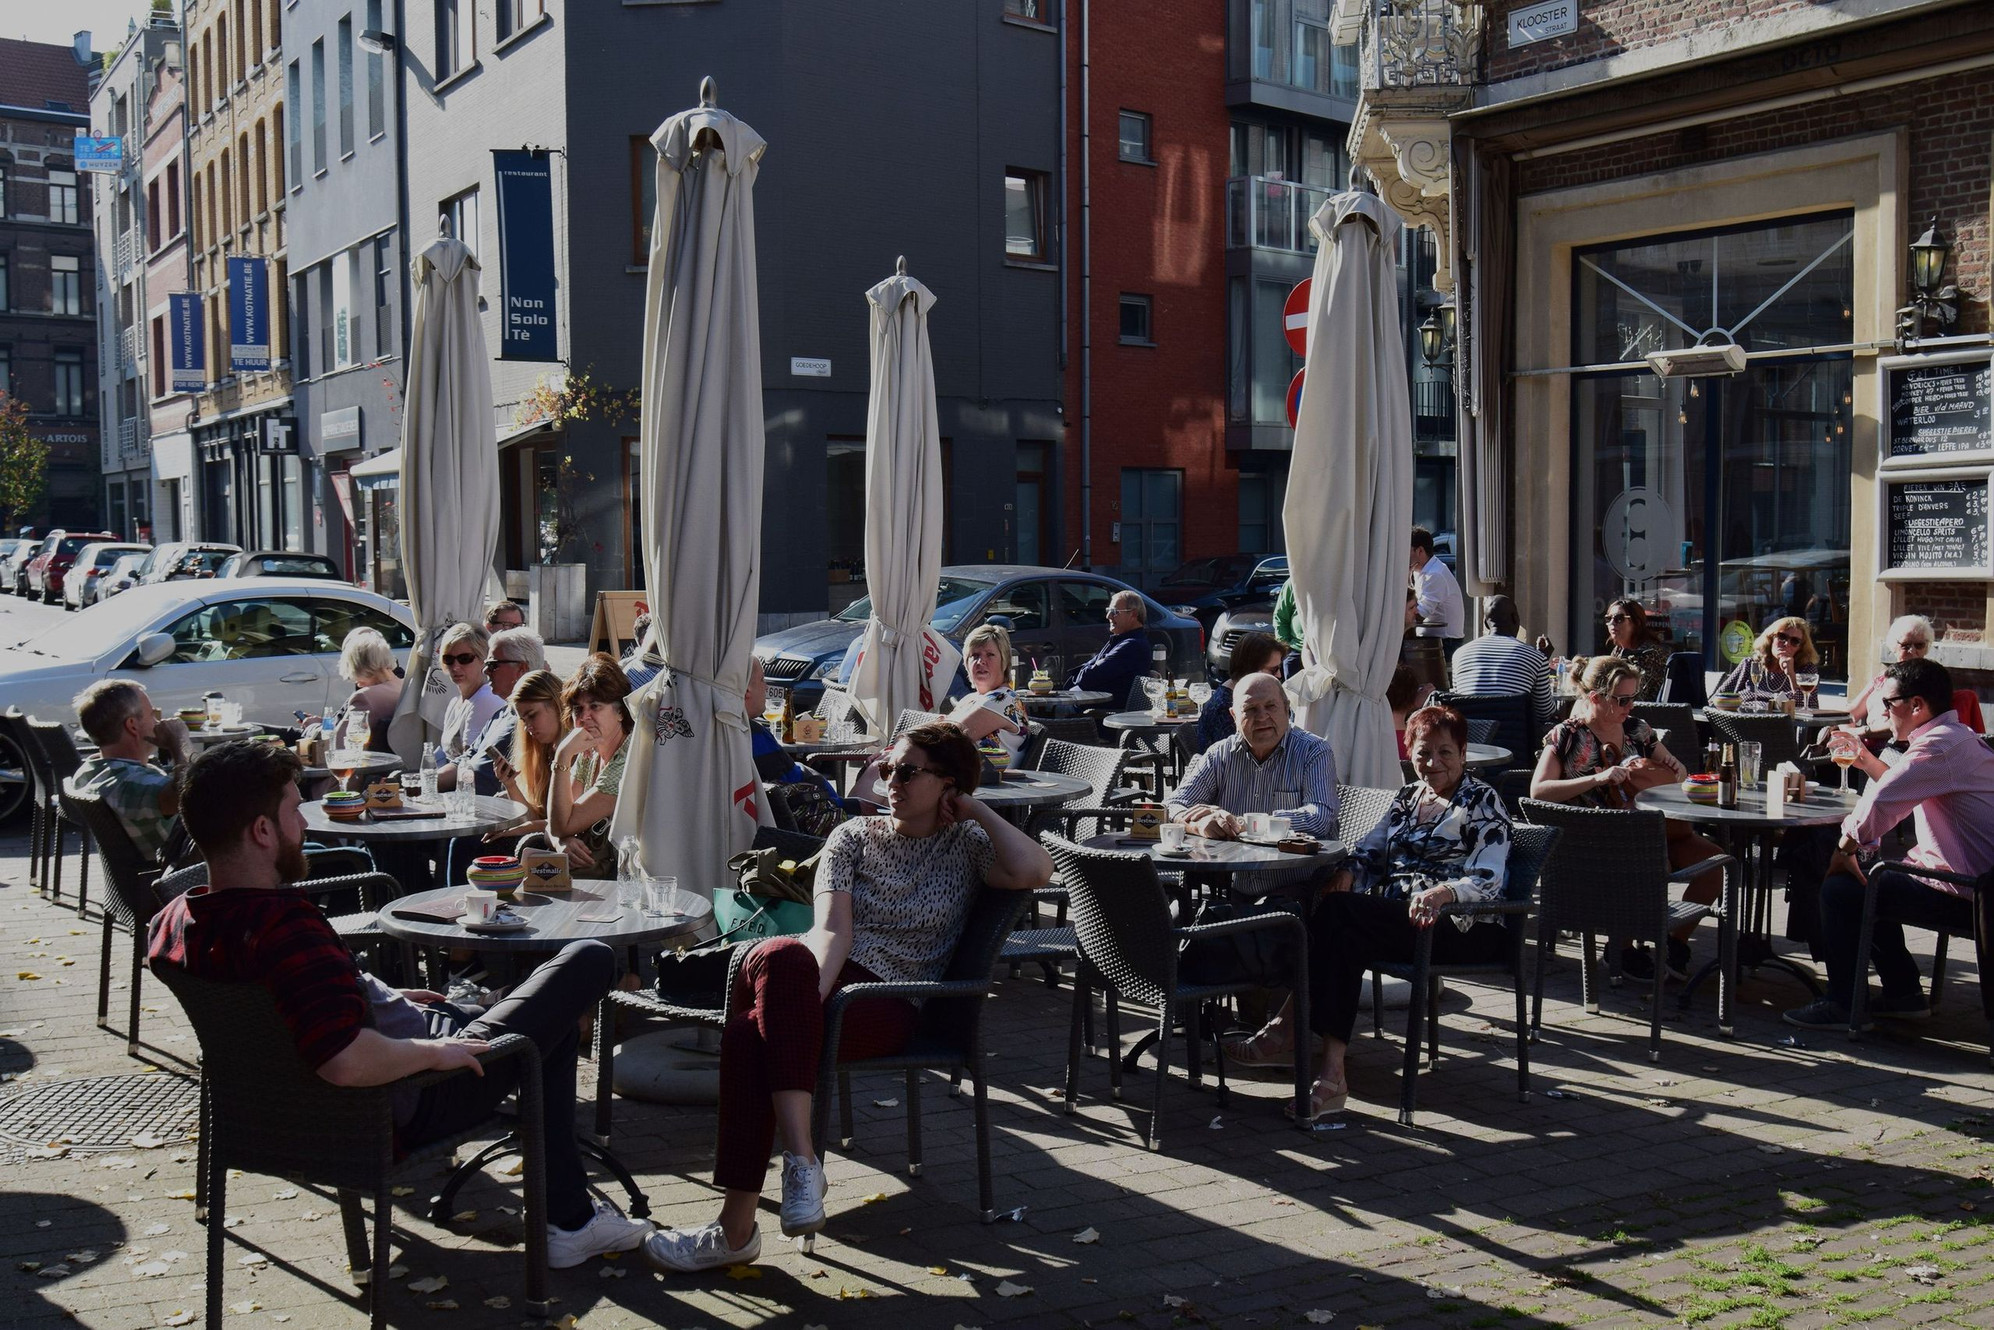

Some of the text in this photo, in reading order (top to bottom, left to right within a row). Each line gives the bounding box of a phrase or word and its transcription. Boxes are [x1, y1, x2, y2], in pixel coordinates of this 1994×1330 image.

[1516, 6, 1568, 30] KLOOSTER
[1545, 22, 1568, 34] STRAAT
[244, 262, 255, 344] WWW.KOTNATIE.BE
[510, 296, 544, 309] Non
[510, 313, 548, 325] Solo
[182, 298, 193, 369] WWW.KOTNATIE.BE
[512, 329, 531, 341] Tè
[245, 358, 268, 366] HUUR
[1913, 406, 1931, 415] BIER
[1896, 415, 1936, 426] WATERLOO
[46, 434, 88, 443] ARTOIS
[1892, 504, 1914, 512] TRIPLE
